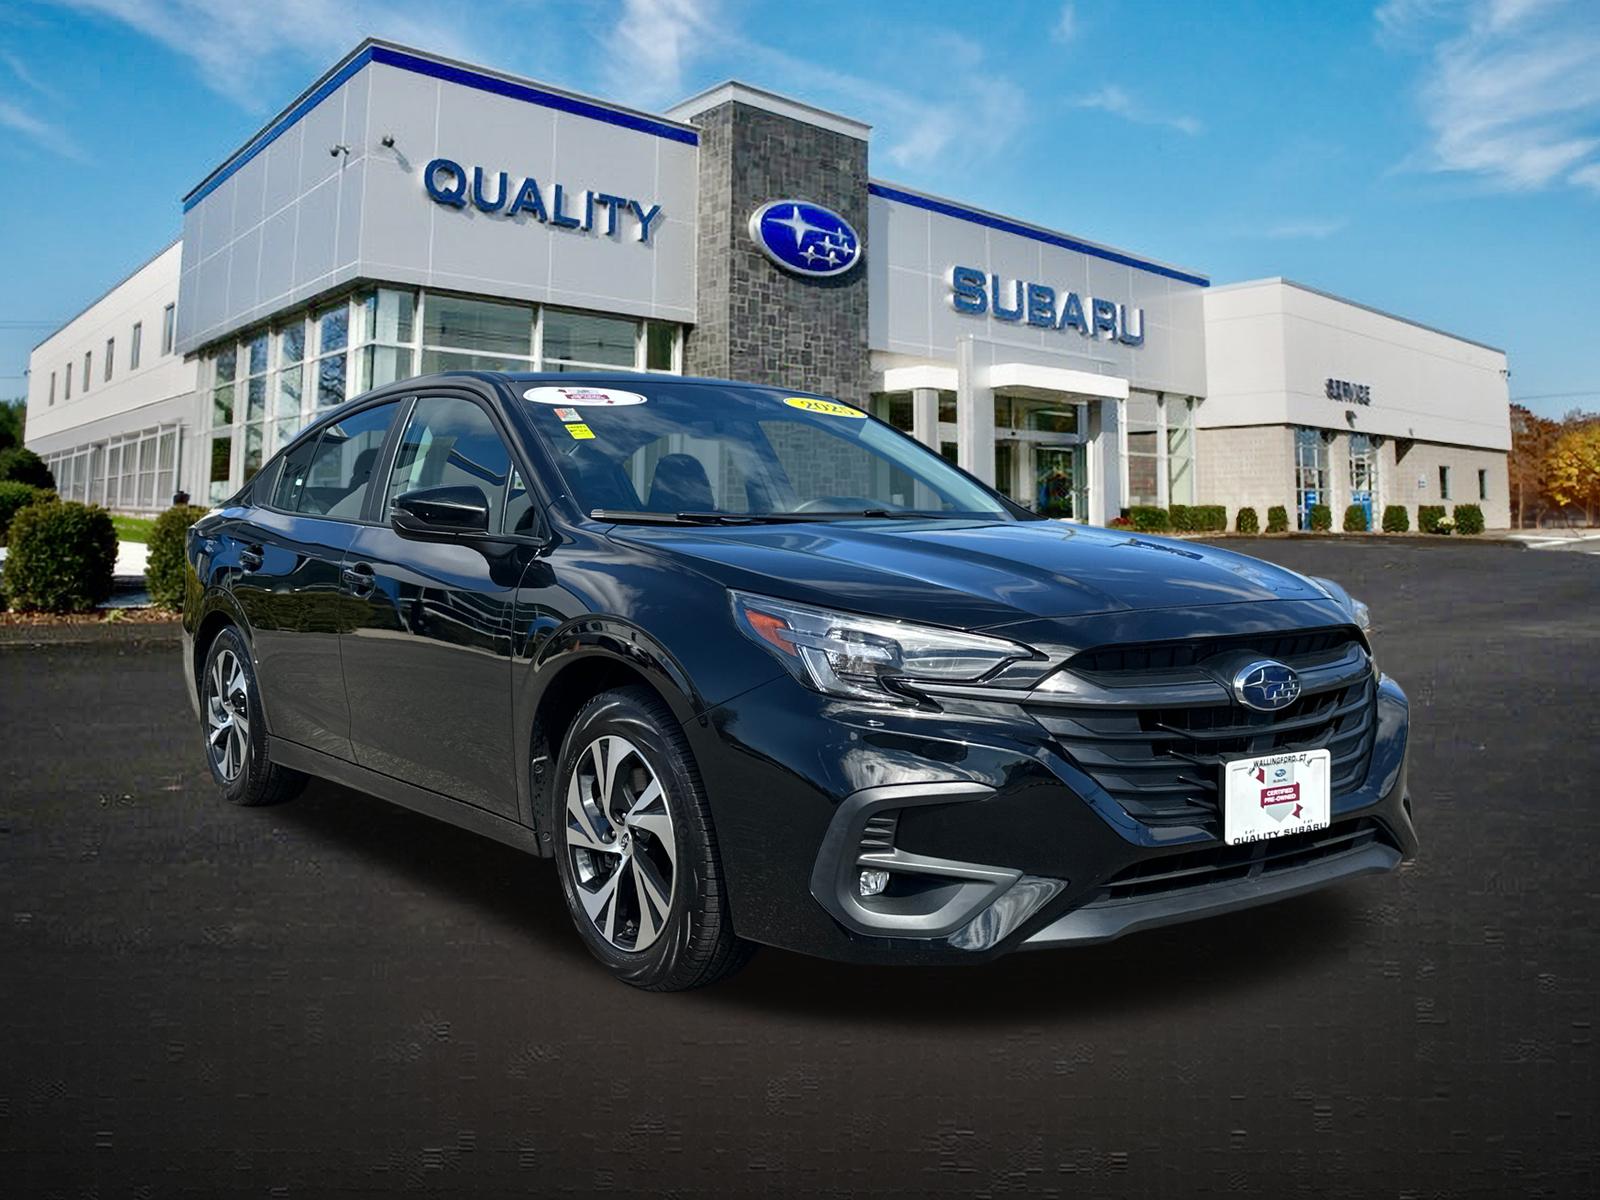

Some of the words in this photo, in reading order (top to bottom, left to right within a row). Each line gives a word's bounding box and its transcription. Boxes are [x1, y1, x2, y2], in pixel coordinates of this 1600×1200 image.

[424, 159, 661, 242] QUALITY
[952, 266, 1144, 346] SUBARU
[1325, 378, 1370, 406] SERVICE
[1233, 831, 1280, 845] QUALITY
[1284, 822, 1327, 837] SUBARU
